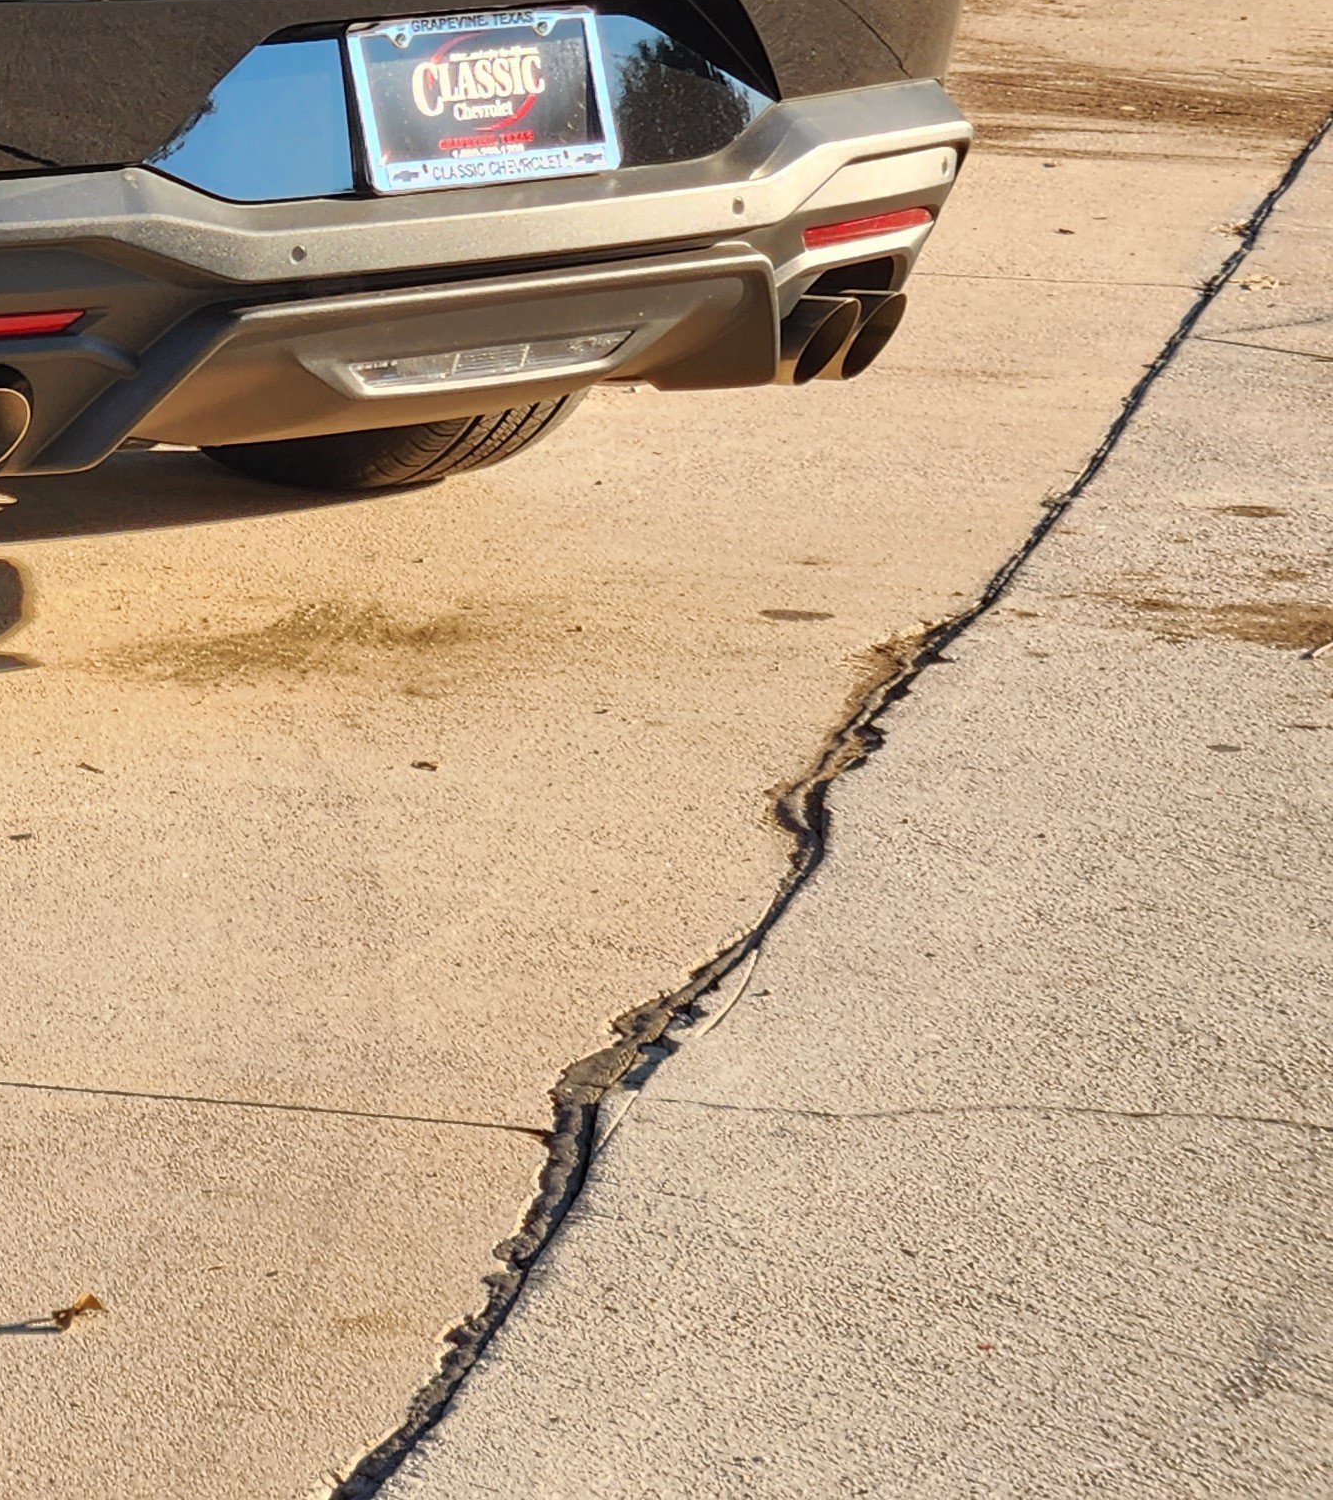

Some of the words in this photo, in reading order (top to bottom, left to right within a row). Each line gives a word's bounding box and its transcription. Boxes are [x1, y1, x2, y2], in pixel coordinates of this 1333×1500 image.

[492, 10, 534, 26] TEXAS
[412, 54, 546, 117] CLASSIC
[453, 99, 515, 122] Chevrolet
[433, 162, 485, 180] CLASSIC
[490, 154, 562, 175] CHEVROLET
